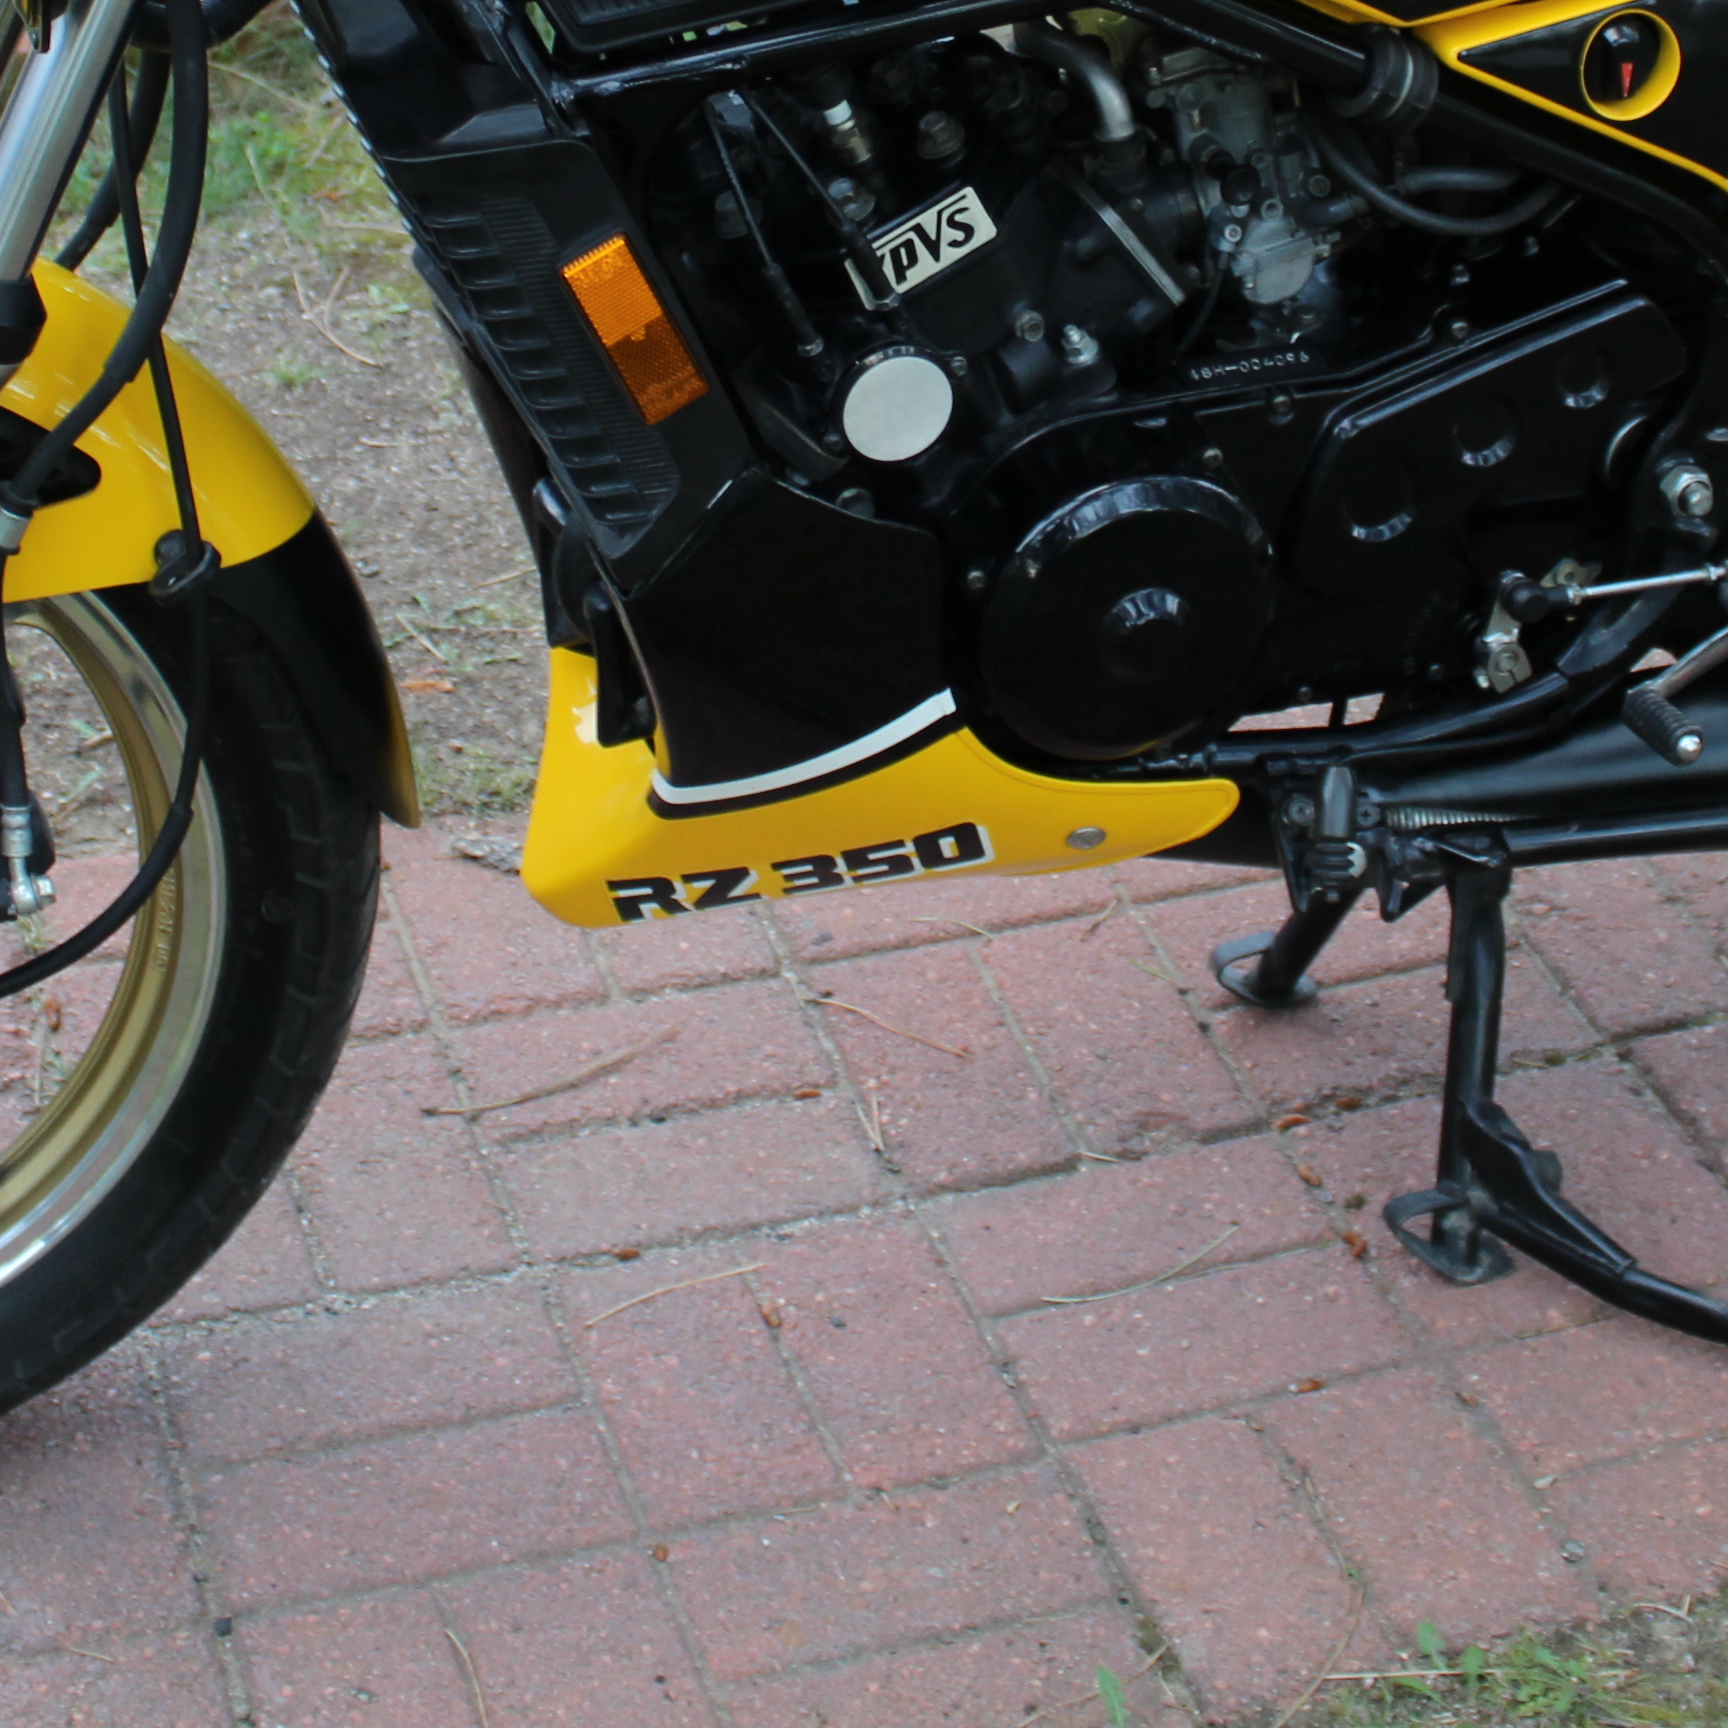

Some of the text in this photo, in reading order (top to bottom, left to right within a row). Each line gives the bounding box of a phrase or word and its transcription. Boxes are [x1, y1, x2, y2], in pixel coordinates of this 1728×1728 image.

[875, 194, 976, 286] PVS
[605, 821, 995, 923] RZ 350
